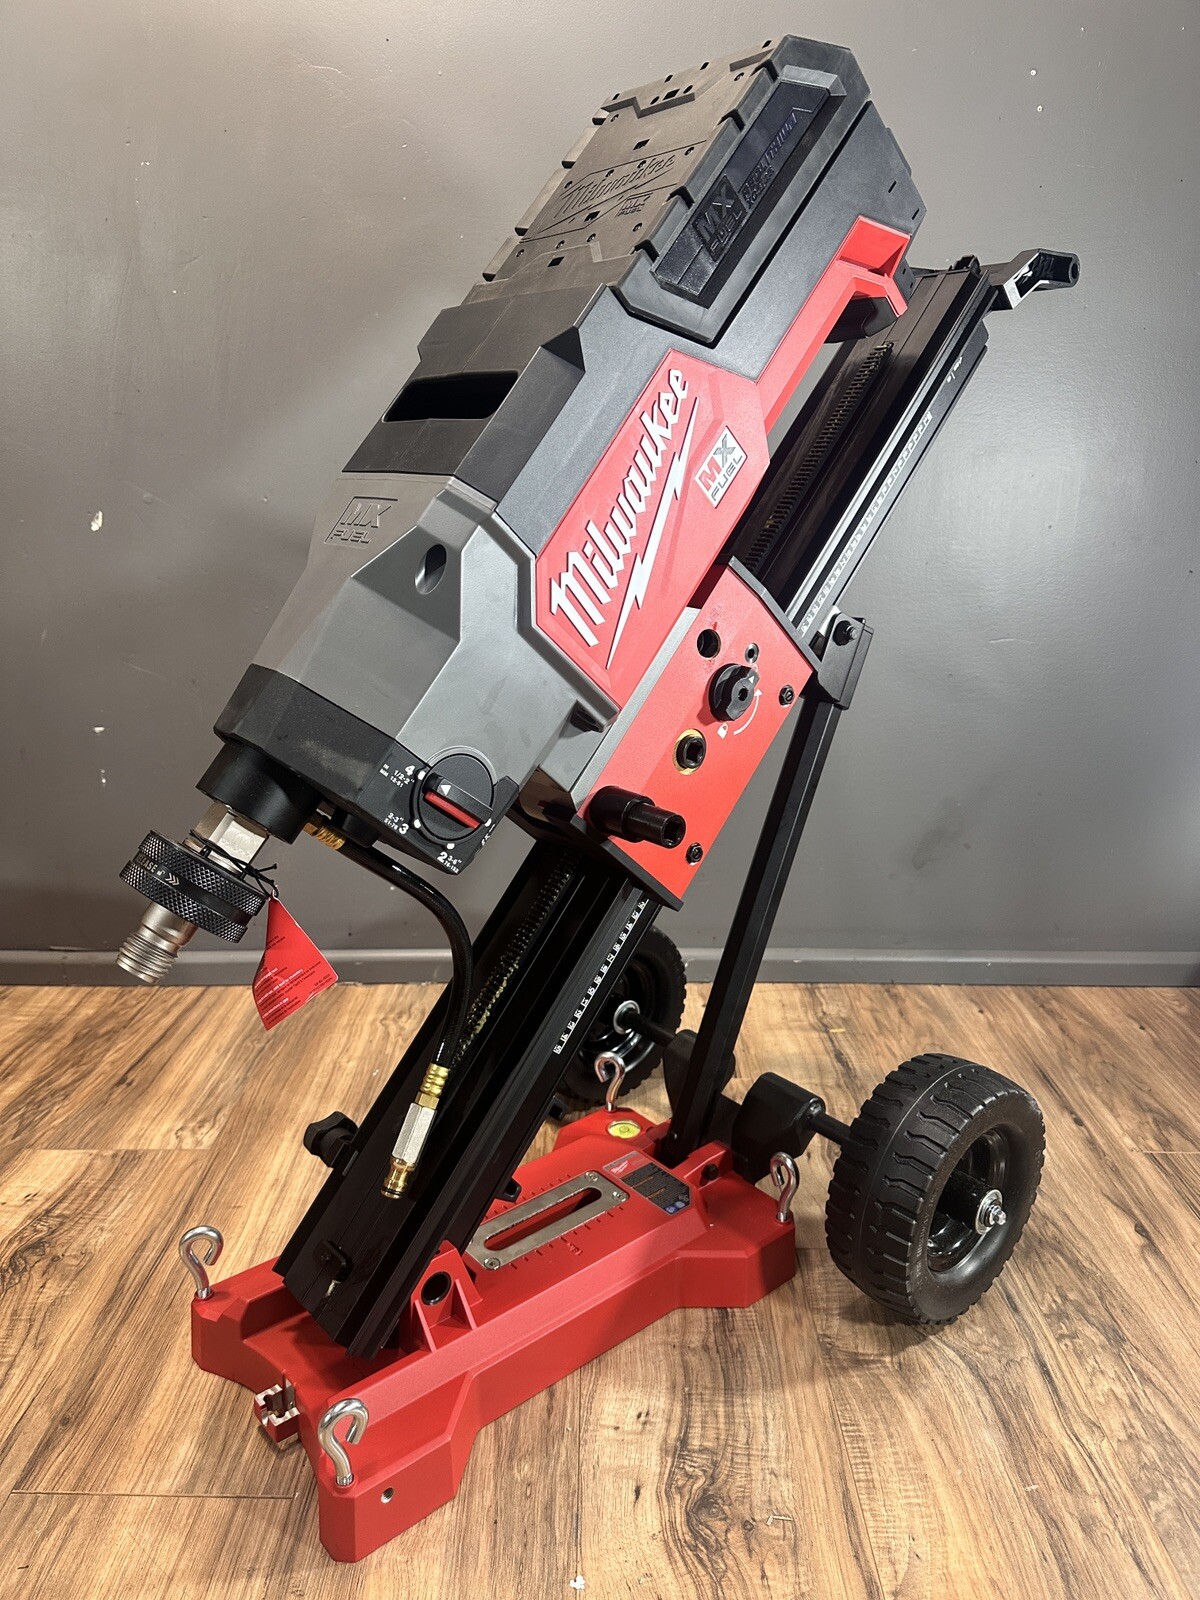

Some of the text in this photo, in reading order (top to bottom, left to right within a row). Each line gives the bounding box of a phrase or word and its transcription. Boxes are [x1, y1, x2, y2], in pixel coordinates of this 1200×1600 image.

[696, 183, 736, 242] MX
[711, 210, 743, 255] FUEL
[698, 433, 736, 492] MX
[711, 455, 743, 502] FUEL
[340, 502, 392, 528] MX
[550, 368, 689, 647] Milwaukee
[330, 529, 372, 544] FUEL
[405, 764, 416, 776] 4
[398, 823, 410, 835] 3
[436, 851, 448, 864] 2
